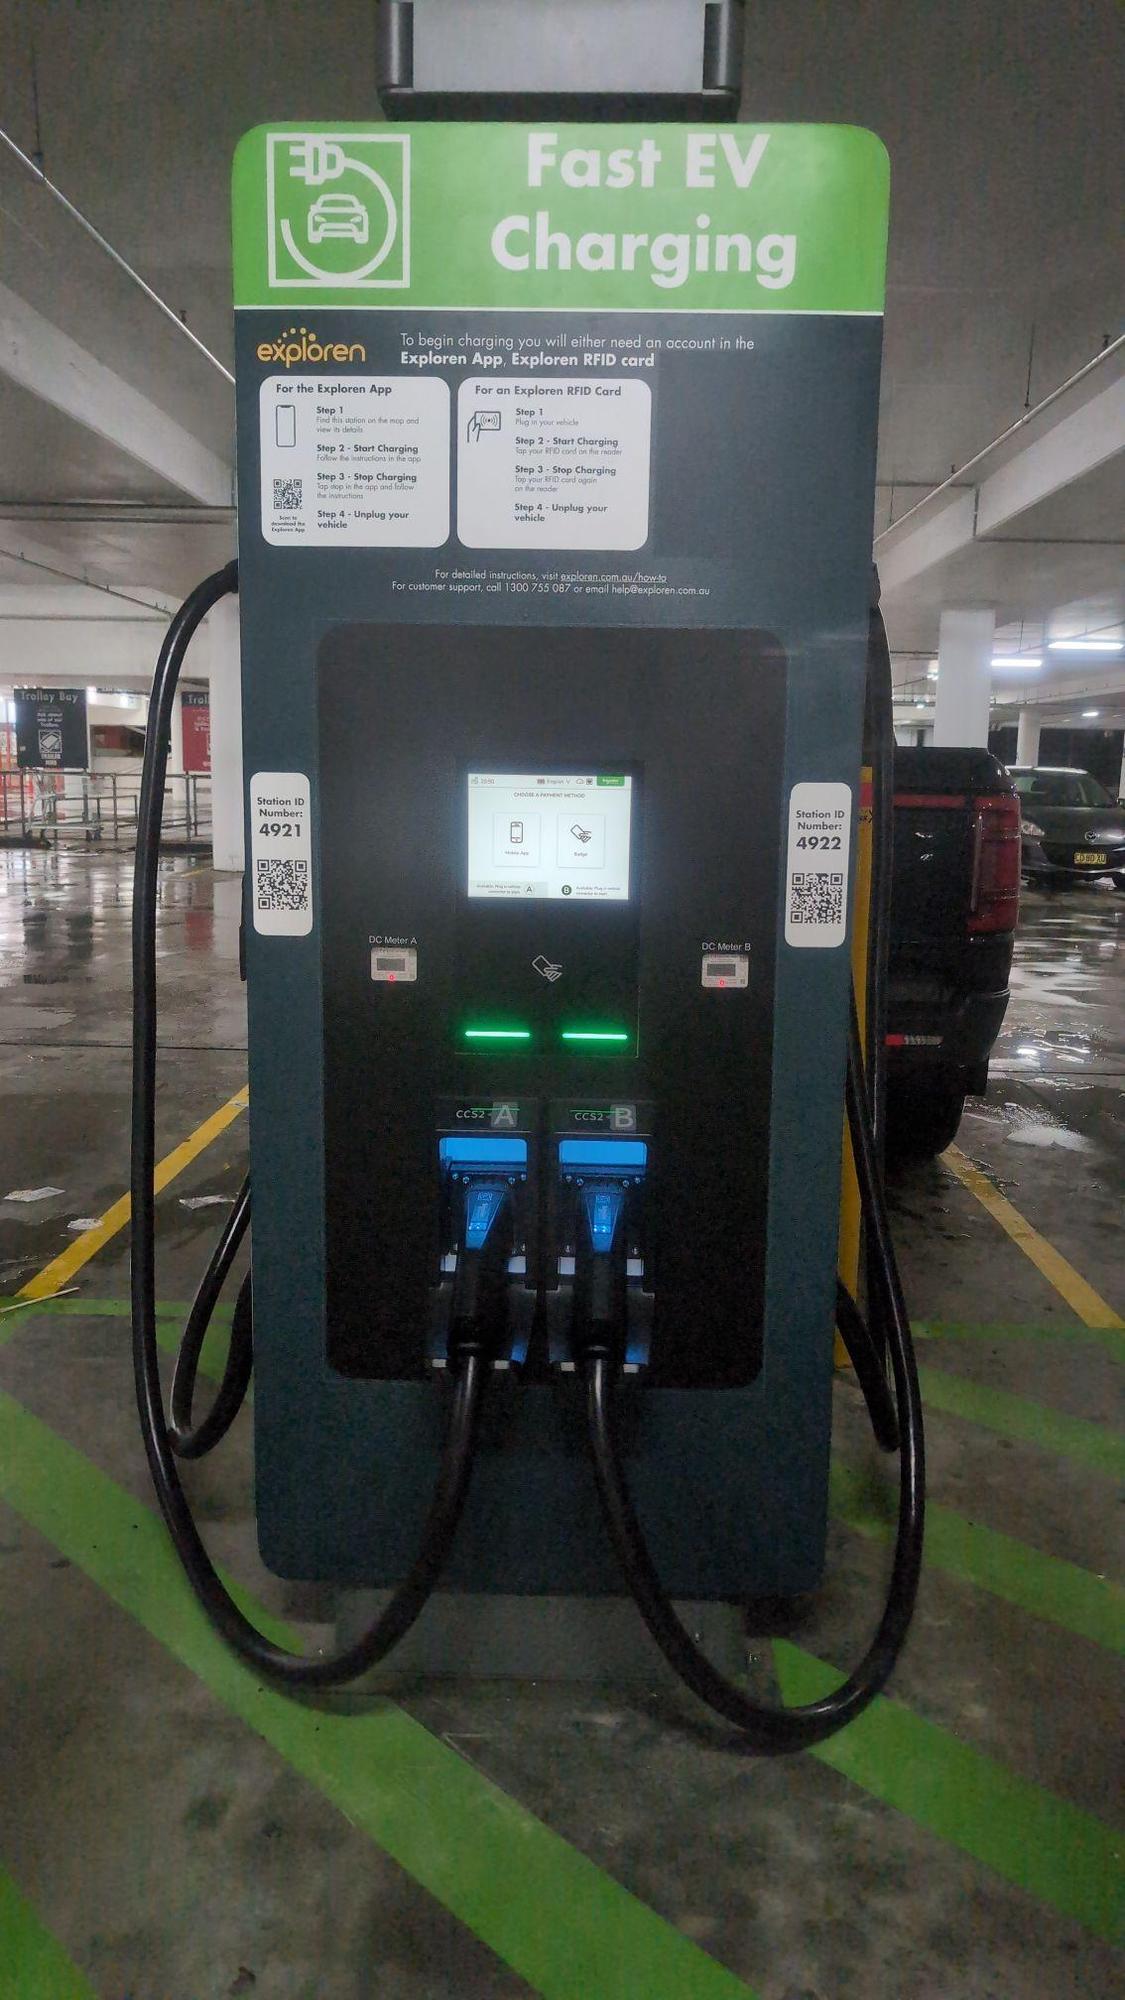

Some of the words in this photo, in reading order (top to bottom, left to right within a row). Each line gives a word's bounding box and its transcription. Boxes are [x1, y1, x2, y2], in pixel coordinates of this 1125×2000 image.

[528, 133, 662, 188] Fast
[687, 133, 770, 188] EV
[490, 211, 798, 289] Charging
[400, 332, 414, 346] To
[418, 332, 454, 350] begin
[458, 333, 514, 351] charging
[518, 338, 541, 351] you
[546, 333, 567, 348] will
[571, 334, 606, 349] either
[610, 334, 642, 348] need
[646, 337, 662, 349] an
[666, 336, 717, 350] account
[720, 337, 731, 350] in
[735, 335, 755, 350] the
[256, 336, 366, 369] exploren
[400, 351, 468, 368] Exploren
[471, 352, 507, 369] App,
[511, 352, 578, 369] Exploren
[583, 353, 617, 367] RFID
[621, 352, 655, 367] card
[276, 383, 294, 394] For
[297, 383, 314, 394] the
[317, 383, 366, 396] Exploren
[369, 384, 392, 397] App
[475, 385, 493, 395] For
[496, 387, 511, 395] an
[514, 385, 563, 397] Exploren
[567, 386, 592, 396] RFID
[595, 386, 622, 396] Card
[316, 406, 336, 416] Step
[339, 406, 344, 414] 1
[515, 408, 535, 417] Step
[539, 408, 543, 416] 1
[389, 418, 405, 426] map
[515, 419, 530, 427] Plug
[515, 436, 535, 447] Step
[538, 437, 544, 445] 2
[552, 437, 575, 445] Start
[577, 437, 619, 448] Charging
[316, 444, 336, 454] Step
[338, 444, 345, 452] 2
[353, 444, 375, 452] Start
[377, 444, 419, 454] Charging
[515, 447, 527, 455] Tap
[561, 447, 577, 455] card
[316, 454, 337, 462] Follow
[352, 454, 386, 462] instructions
[408, 456, 421, 464] app
[515, 465, 535, 475] Step
[537, 465, 543, 473] 3
[552, 466, 573, 475] Stop
[575, 466, 617, 476] Charging
[316, 472, 337, 482] Step
[339, 472, 345, 480] 3
[353, 473, 374, 483] Stop
[376, 472, 417, 483] Charging
[544, 475, 559, 483] RFID
[577, 477, 597, 485] again
[317, 482, 329, 490] Tap
[364, 484, 378, 492] app
[394, 483, 415, 491] follow
[328, 492, 364, 500] instructions
[514, 503, 534, 512] Step
[537, 503, 543, 511] 4
[552, 504, 584, 513] Unplug
[586, 505, 608, 513] your
[317, 510, 337, 519] Step
[339, 510, 345, 518] 4
[354, 510, 386, 520] Unplug
[388, 511, 409, 519] your
[514, 513, 545, 522] vehicle
[317, 520, 348, 529] vehicle
[435, 569, 449, 579] For
[452, 569, 486, 580] detailed
[489, 570, 539, 581] instructions,
[542, 571, 558, 581] visit
[392, 581, 406, 591] For
[408, 581, 446, 591] customer
[449, 583, 484, 594] support,
[486, 583, 502, 592] call
[505, 583, 529, 593] 1300
[531, 583, 550, 593] 755
[552, 583, 571, 593] 087
[585, 584, 609, 594] email
[611, 584, 710, 597] help@exploren.com.au
[59, 691, 79, 704] Bay
[513, 791, 535, 799] CHOOSE
[257, 796, 292, 806] Station
[294, 797, 305, 806] ID
[259, 808, 303, 818] Number:
[795, 809, 831, 819] Station
[834, 810, 845, 819] ID
[259, 822, 301, 837] 4921
[797, 821, 842, 831] Number:
[796, 836, 841, 850] 4922
[369, 935, 383, 944] DC
[384, 936, 408, 944] Meter
[410, 936, 418, 945] A
[702, 942, 716, 951] DC
[717, 943, 743, 951] Meter
[744, 943, 751, 951] B
[456, 1109, 485, 1119] CCS2
[494, 1105, 515, 1126] A
[574, 1112, 604, 1121] CCS2
[615, 1108, 634, 1128] B
